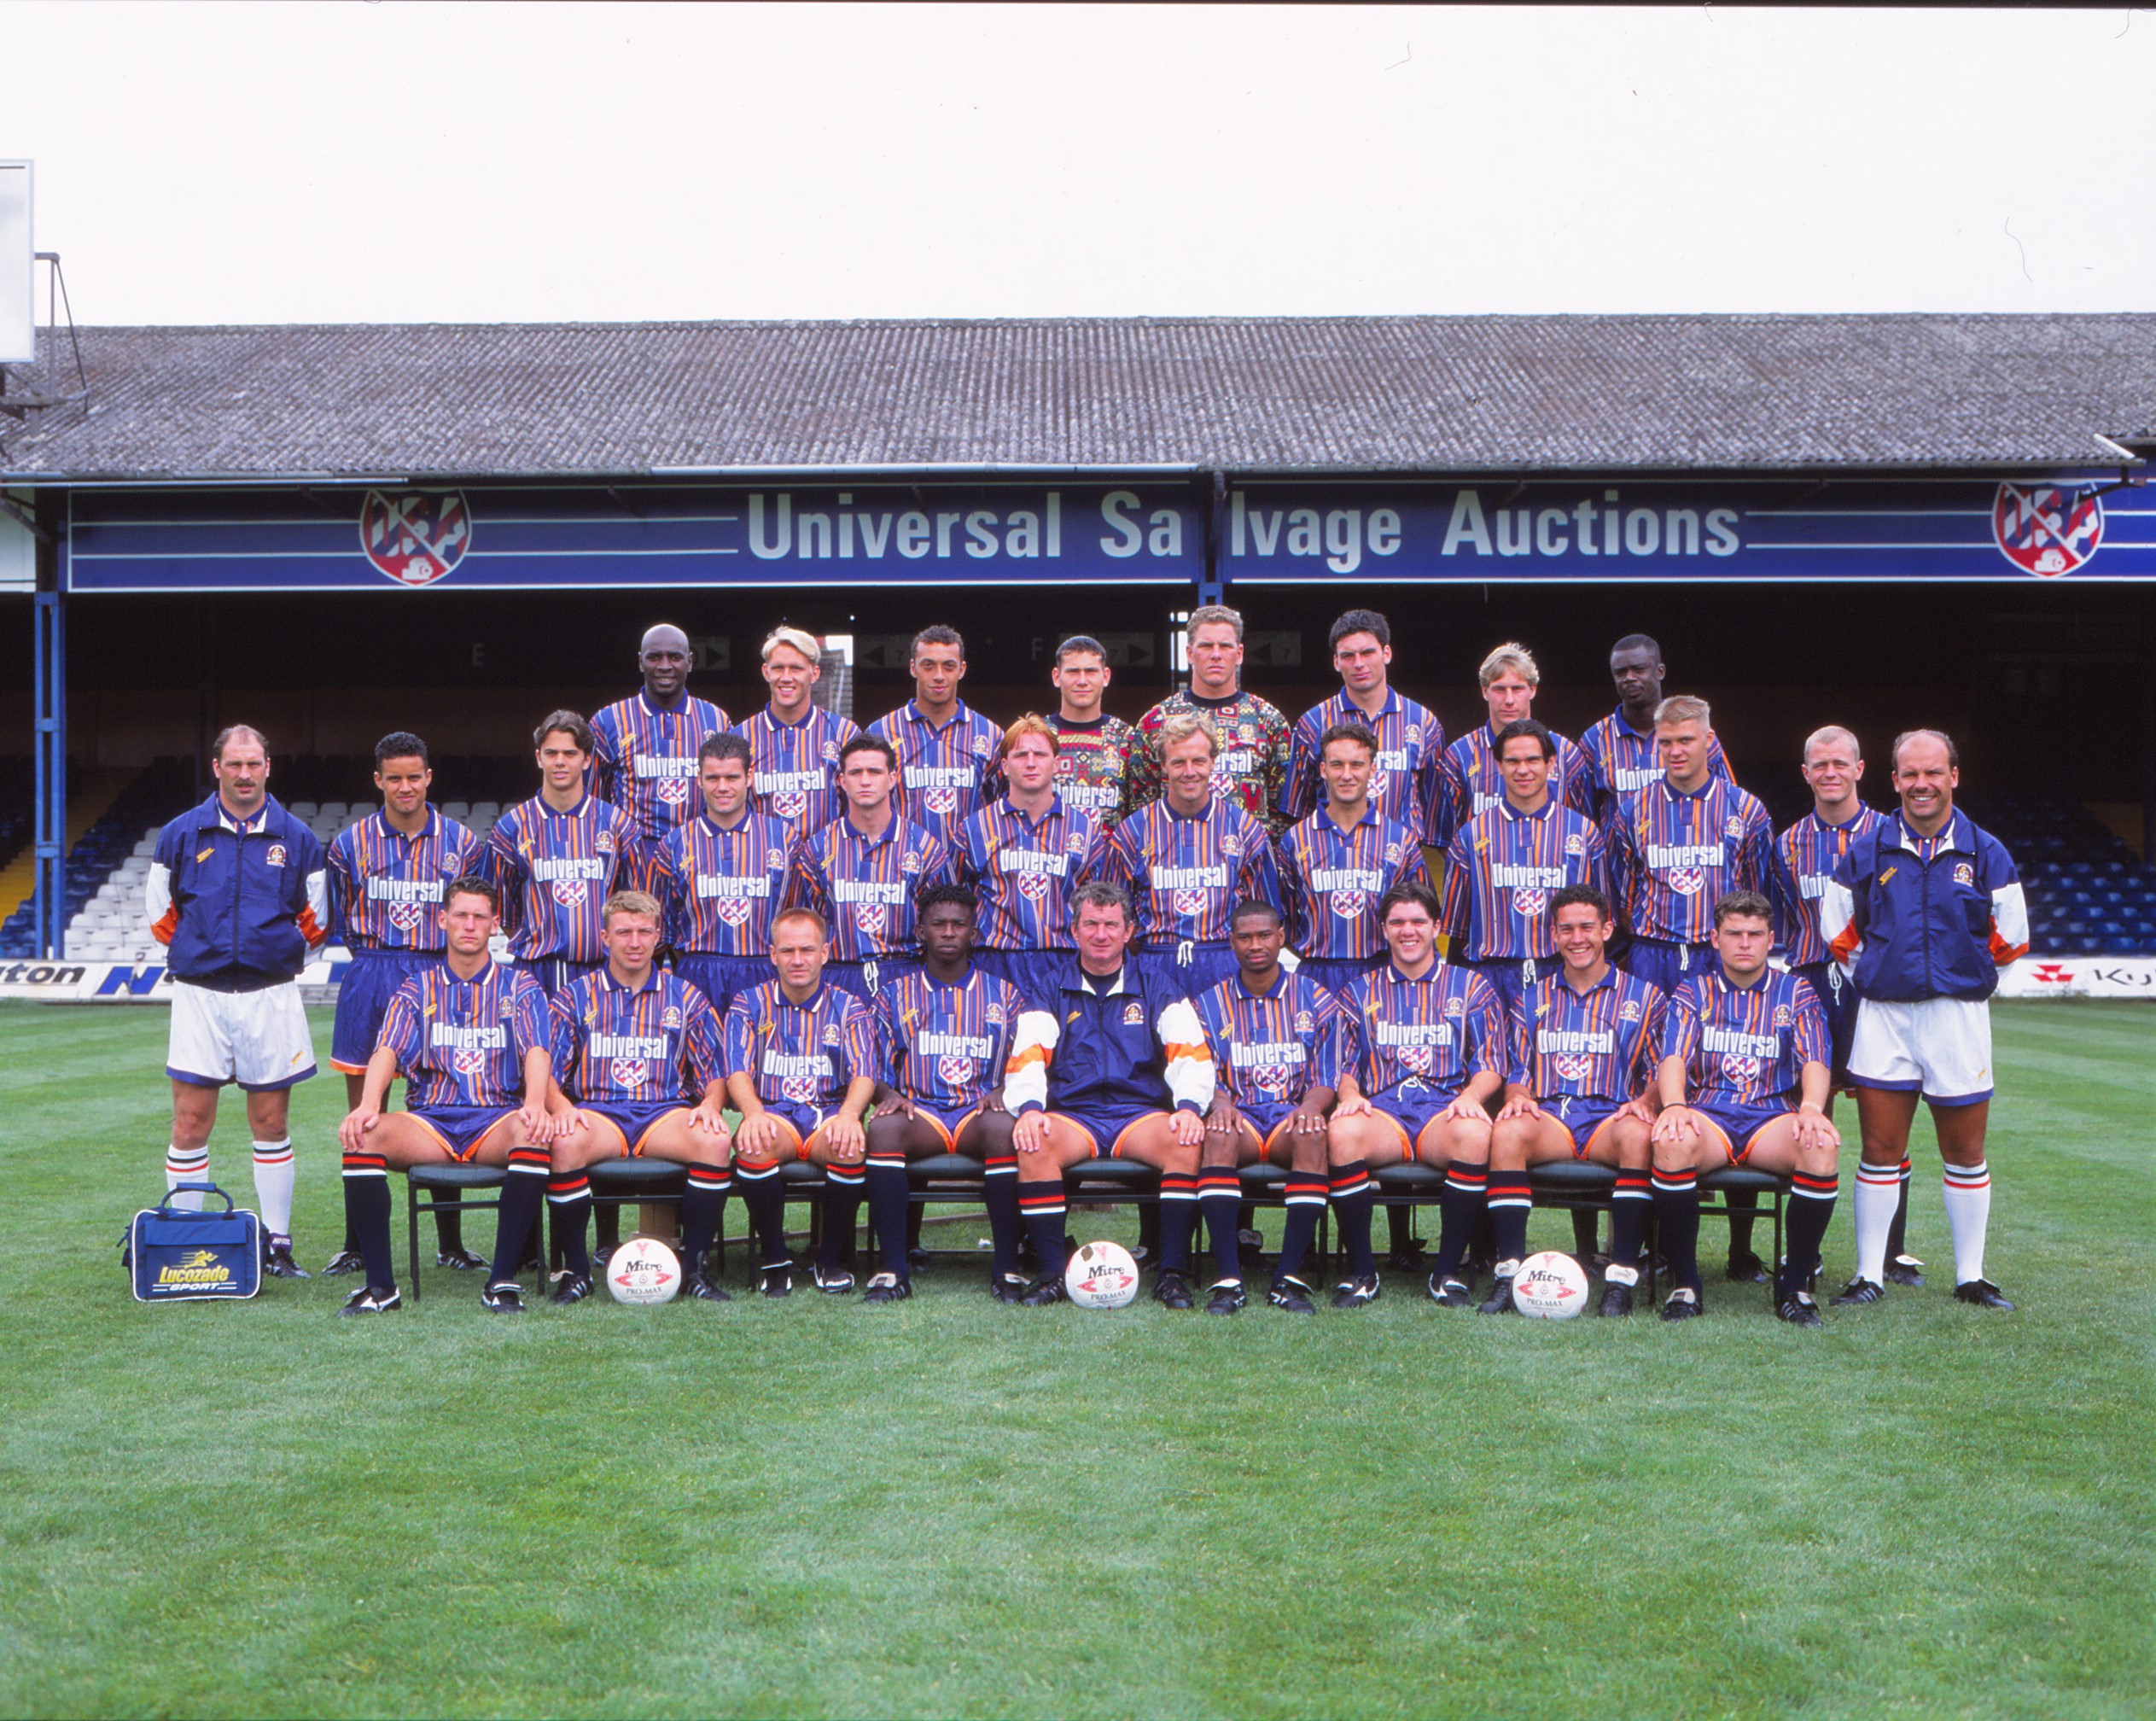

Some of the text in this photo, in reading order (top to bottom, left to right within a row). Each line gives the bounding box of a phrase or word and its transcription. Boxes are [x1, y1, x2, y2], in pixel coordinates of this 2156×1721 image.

[749, 492, 1060, 559] Universal
[1440, 490, 1739, 557] Auctions
[754, 767, 825, 795] Universal
[905, 764, 974, 788] Universal
[533, 855, 604, 882] Universal
[999, 847, 1069, 877] Universal
[1647, 842, 1723, 869] Universal
[697, 872, 770, 898] Universal
[1152, 863, 1227, 890] Universal
[1312, 866, 1383, 892] Universal
[1492, 863, 1567, 888] Universal
[368, 876, 444, 903] Universal
[834, 878, 906, 905] Universal
[0, 963, 86, 983] ton
[432, 1022, 506, 1048] Universal
[591, 1032, 667, 1059] Universal
[918, 1030, 993, 1059] Universal
[1377, 1021, 1451, 1045] Universal
[1537, 1027, 1613, 1053] Universal
[159, 1265, 230, 1283] Lucozade
[625, 1260, 662, 1273] Mitre
[1087, 1264, 1125, 1279] Mitre
[1528, 1269, 1565, 1285] Mitre
[169, 1282, 220, 1291] SPORT
[626, 1286, 662, 1295] PRO-MAX
[1091, 1290, 1126, 1300] PRO-MAX
[1527, 1298, 1564, 1307] PRO-MAX
